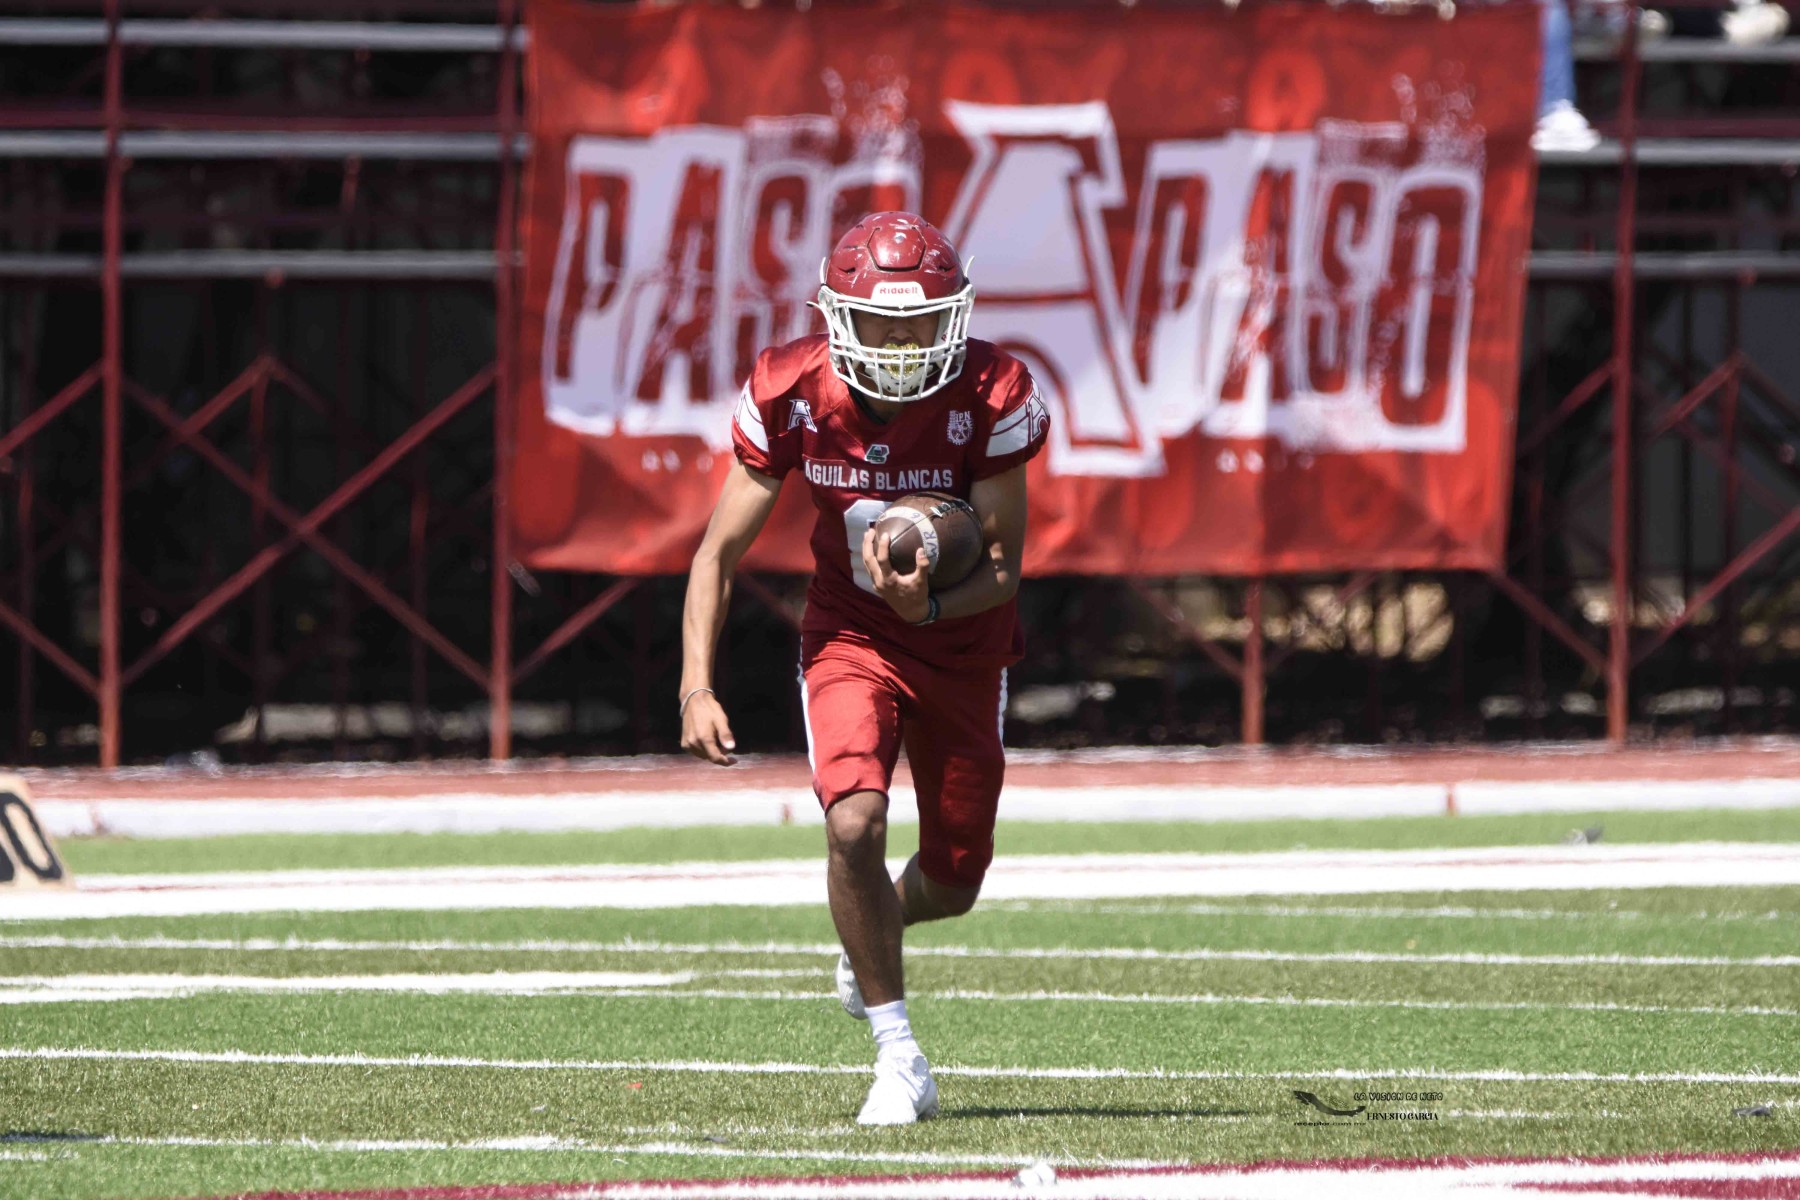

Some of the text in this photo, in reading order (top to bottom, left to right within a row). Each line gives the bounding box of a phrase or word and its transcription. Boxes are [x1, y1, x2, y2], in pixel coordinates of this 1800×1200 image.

[545, 122, 922, 436] PAS
[1128, 130, 1486, 452] PASO
[879, 286, 918, 295] Riddell
[875, 469, 953, 491] BLANCAS
[0, 792, 62, 882] 0
